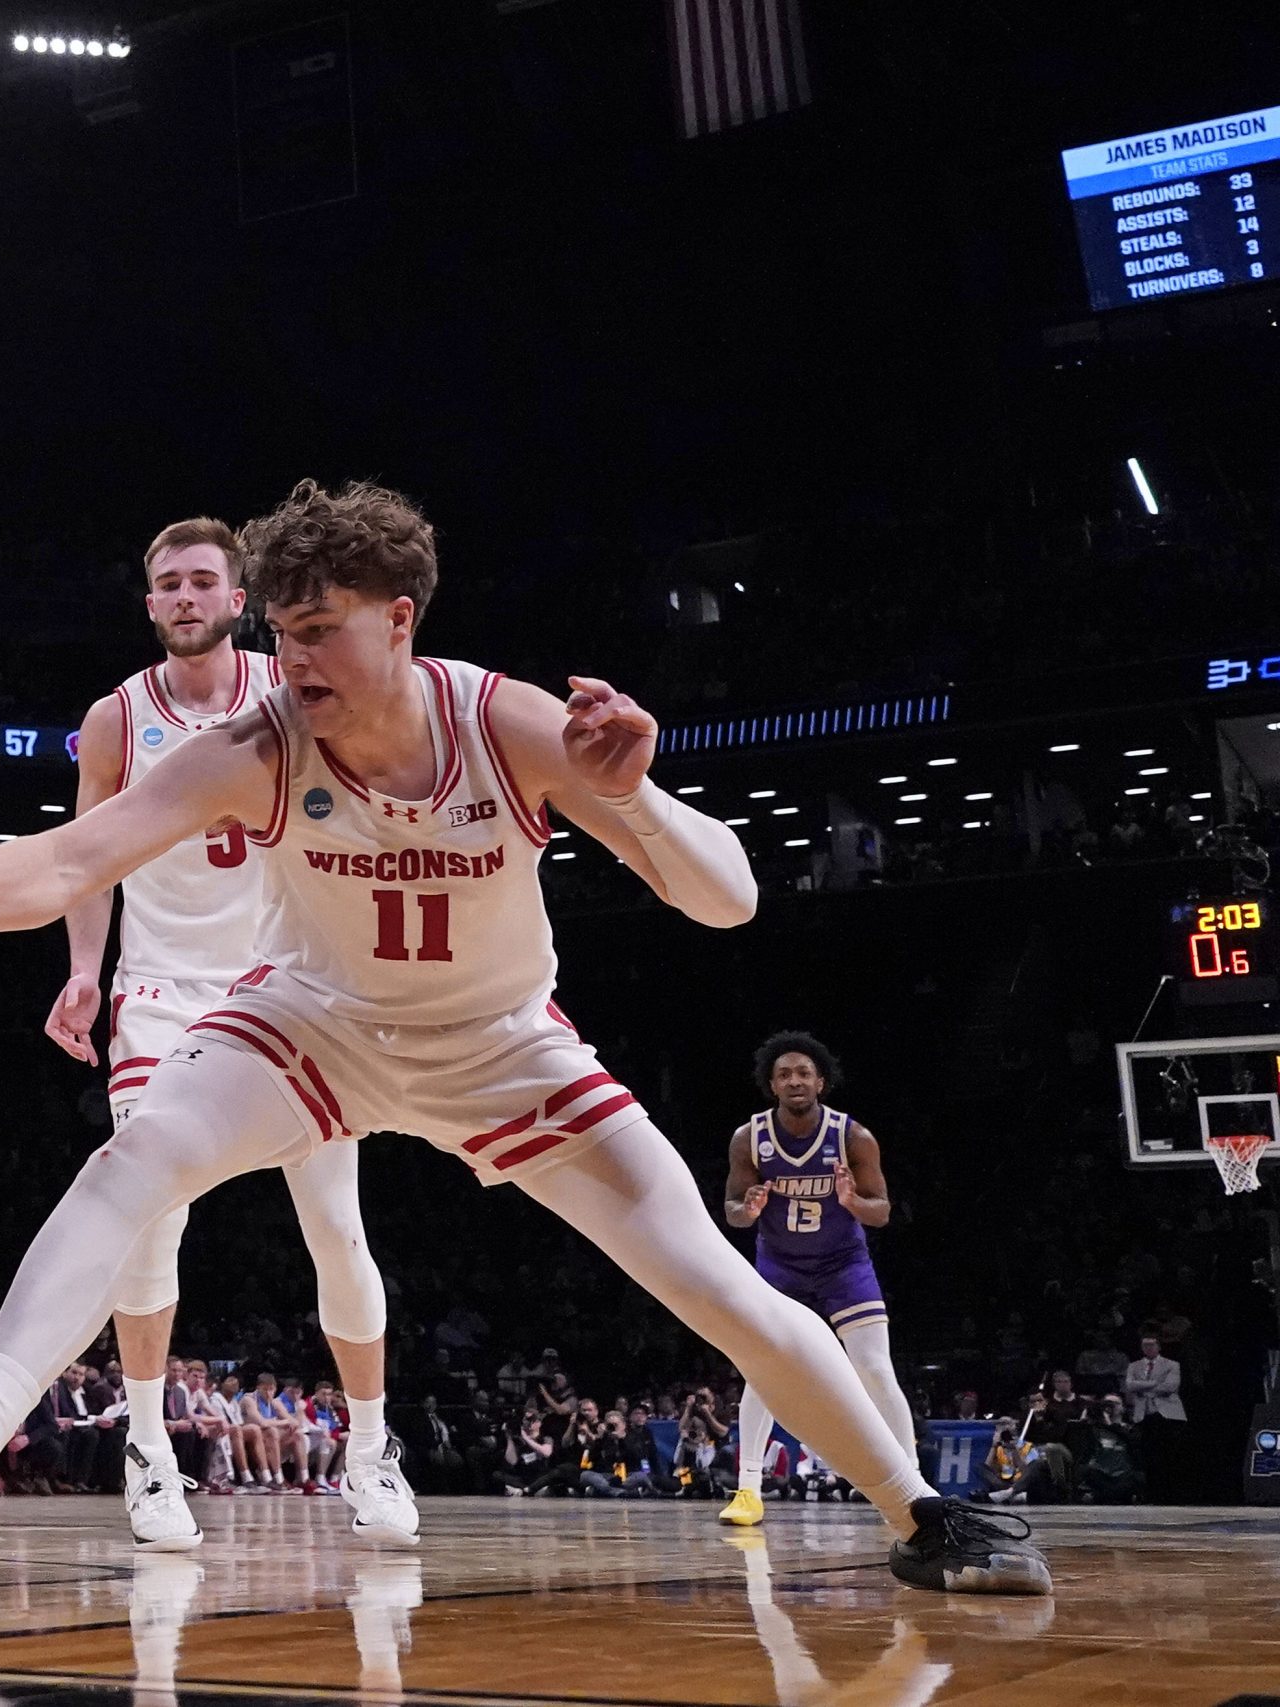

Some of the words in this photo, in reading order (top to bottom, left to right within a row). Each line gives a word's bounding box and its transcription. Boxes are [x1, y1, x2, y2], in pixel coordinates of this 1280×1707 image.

[1105, 137, 1167, 164] JAMES
[1171, 116, 1267, 149] MADISON
[1150, 161, 1187, 179] TEAM
[1188, 151, 1229, 172] STATS
[1112, 181, 1201, 211] REBOUNDS:
[1229, 172, 1253, 190] 33
[1117, 207, 1189, 233] ASSISTS:
[1234, 194, 1256, 212] 12
[1120, 230, 1183, 255] STEALS:
[1237, 216, 1259, 234] 14
[1124, 252, 1190, 277] BLOCKS:
[1246, 239, 1259, 255] 3
[1127, 268, 1224, 299] TURNOVERS:
[4, 728, 38, 757] 57
[303, 844, 505, 882] WISCONSIN
[372, 889, 453, 962] 11
[1197, 903, 1261, 932] 2:03
[1190, 933, 1251, 977] 0.6
[772, 1176, 834, 1197] JMU
[786, 1199, 822, 1233] 13
